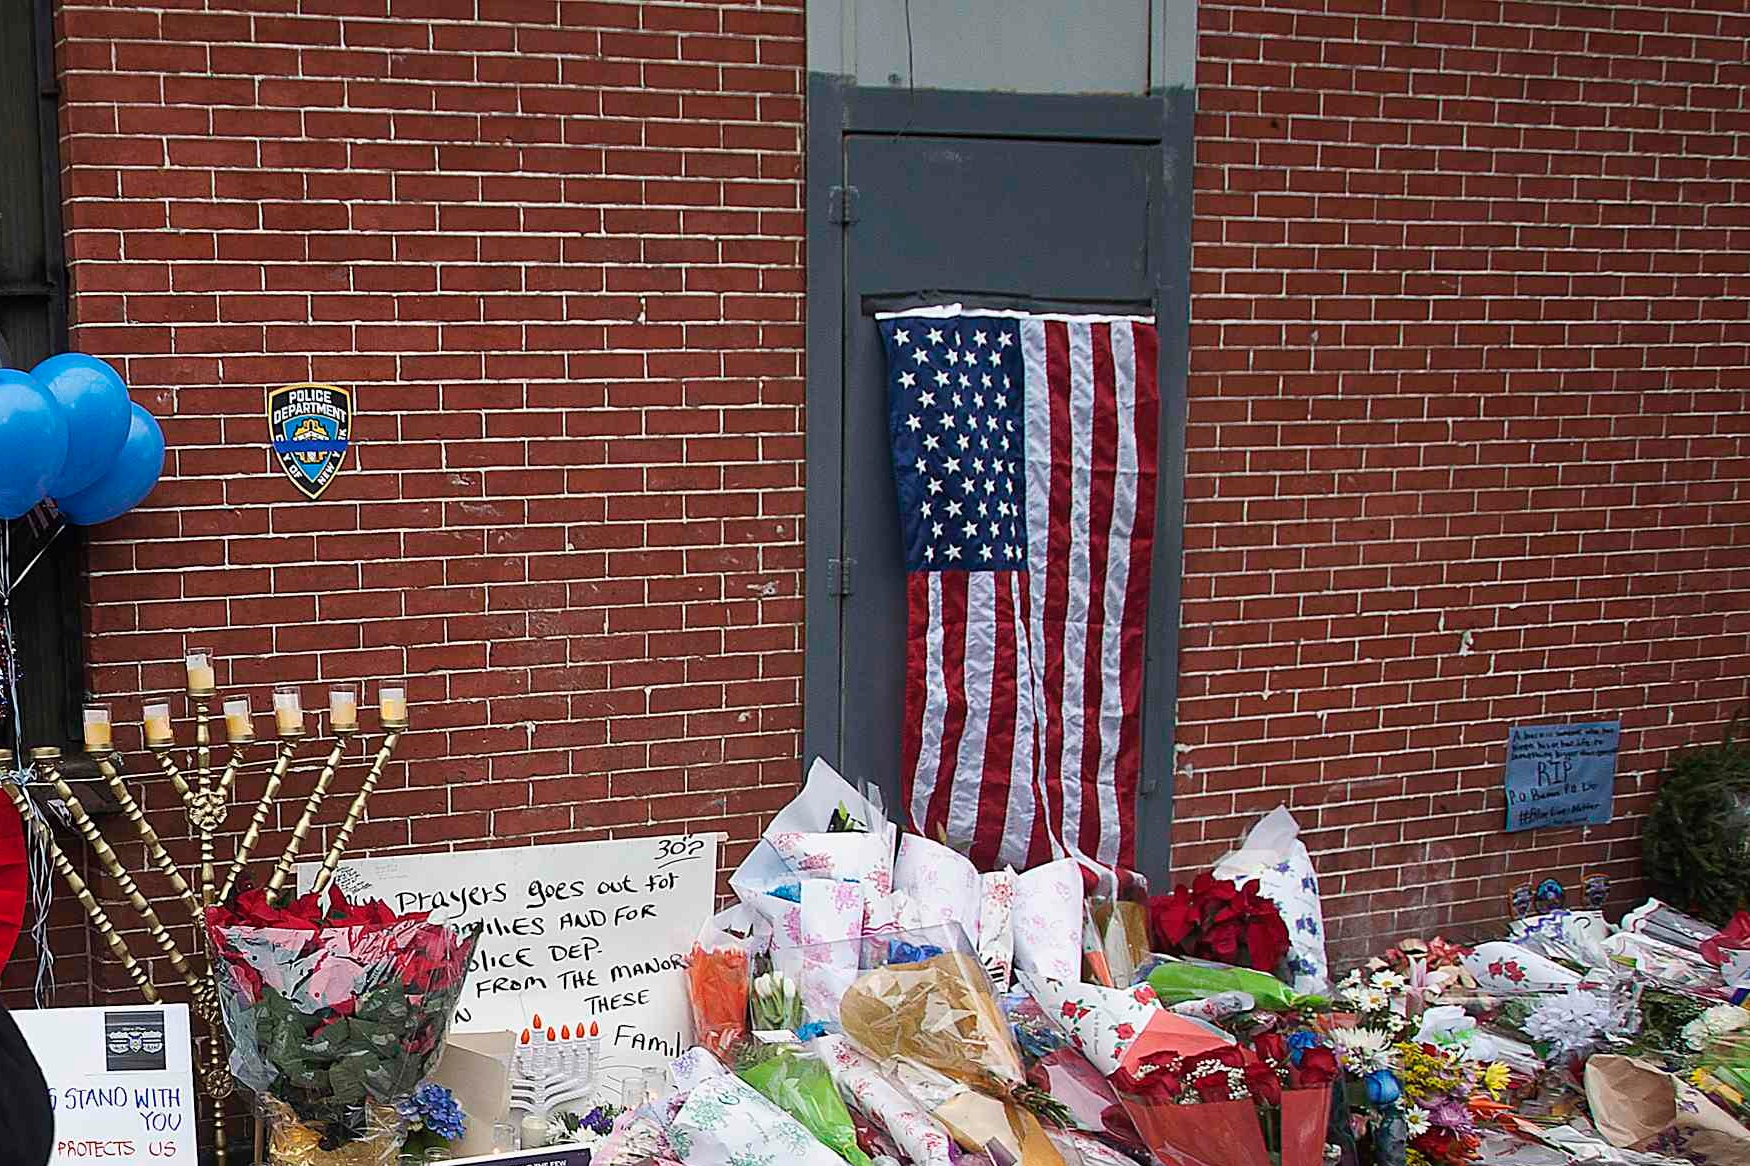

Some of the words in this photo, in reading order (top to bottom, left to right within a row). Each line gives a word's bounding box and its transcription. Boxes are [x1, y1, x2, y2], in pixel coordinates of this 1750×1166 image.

[289, 389, 332, 404] POLICE
[273, 402, 347, 425] DEPARTMENT
[1537, 760, 1572, 787] RIP
[394, 883, 507, 920] Prayers
[526, 879, 585, 909] goes
[597, 874, 639, 895] out
[560, 910, 607, 931] AND
[614, 904, 658, 926] FOR
[476, 976, 547, 999] FROM
[556, 969, 600, 990] THE
[583, 989, 650, 1015] THESE
[64, 1086, 128, 1110] STAND
[134, 1087, 181, 1109] WITH
[139, 1111, 182, 1132] YOU
[57, 1140, 137, 1158] PROTECTS
[148, 1141, 177, 1158] US
